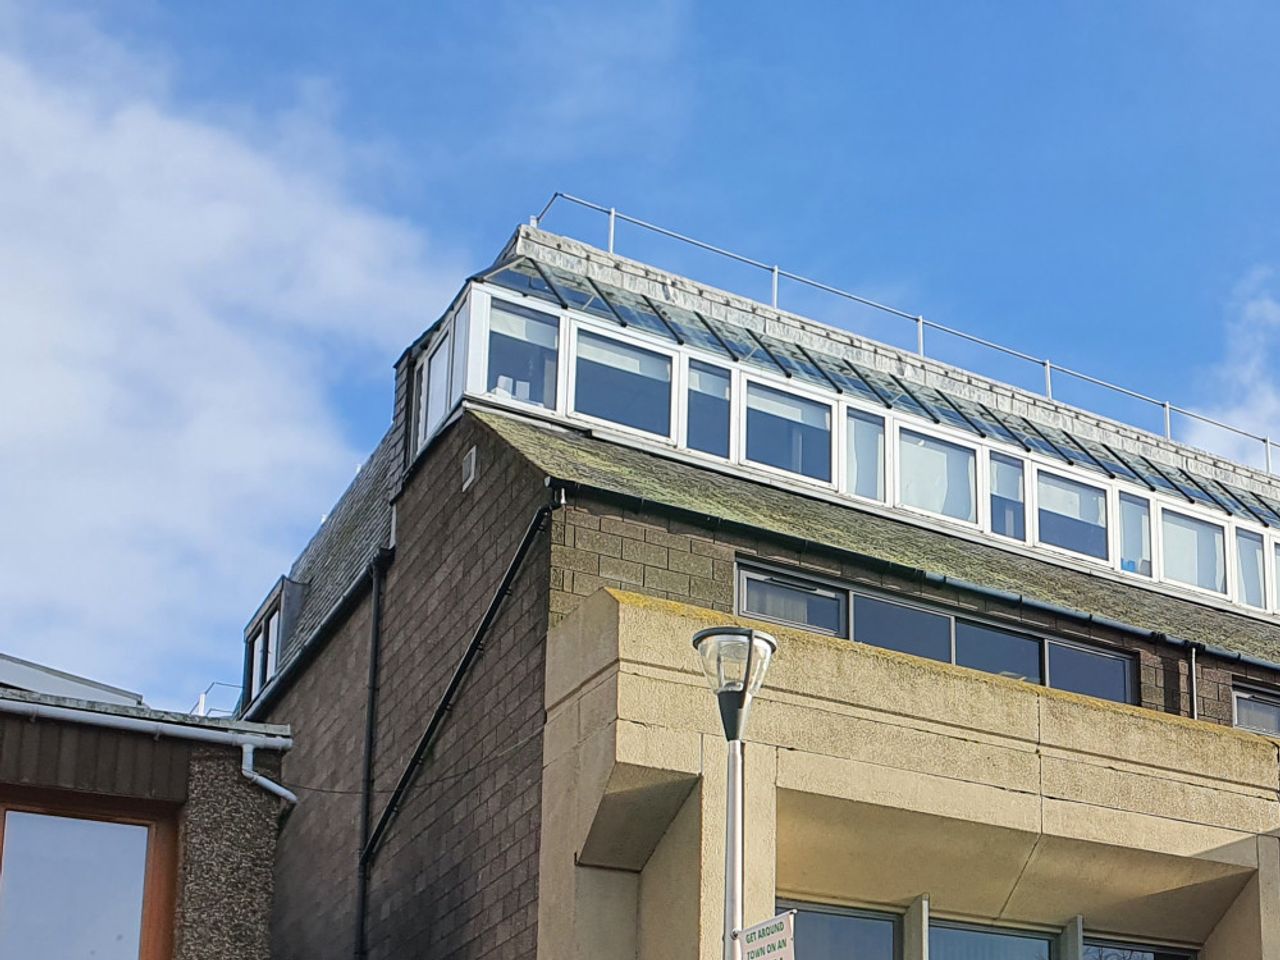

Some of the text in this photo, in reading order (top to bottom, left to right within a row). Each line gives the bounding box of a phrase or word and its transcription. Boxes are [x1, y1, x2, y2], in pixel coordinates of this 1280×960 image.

[746, 922, 784, 944] GET AROUND
[747, 938, 787, 960] TOWN ON AN
